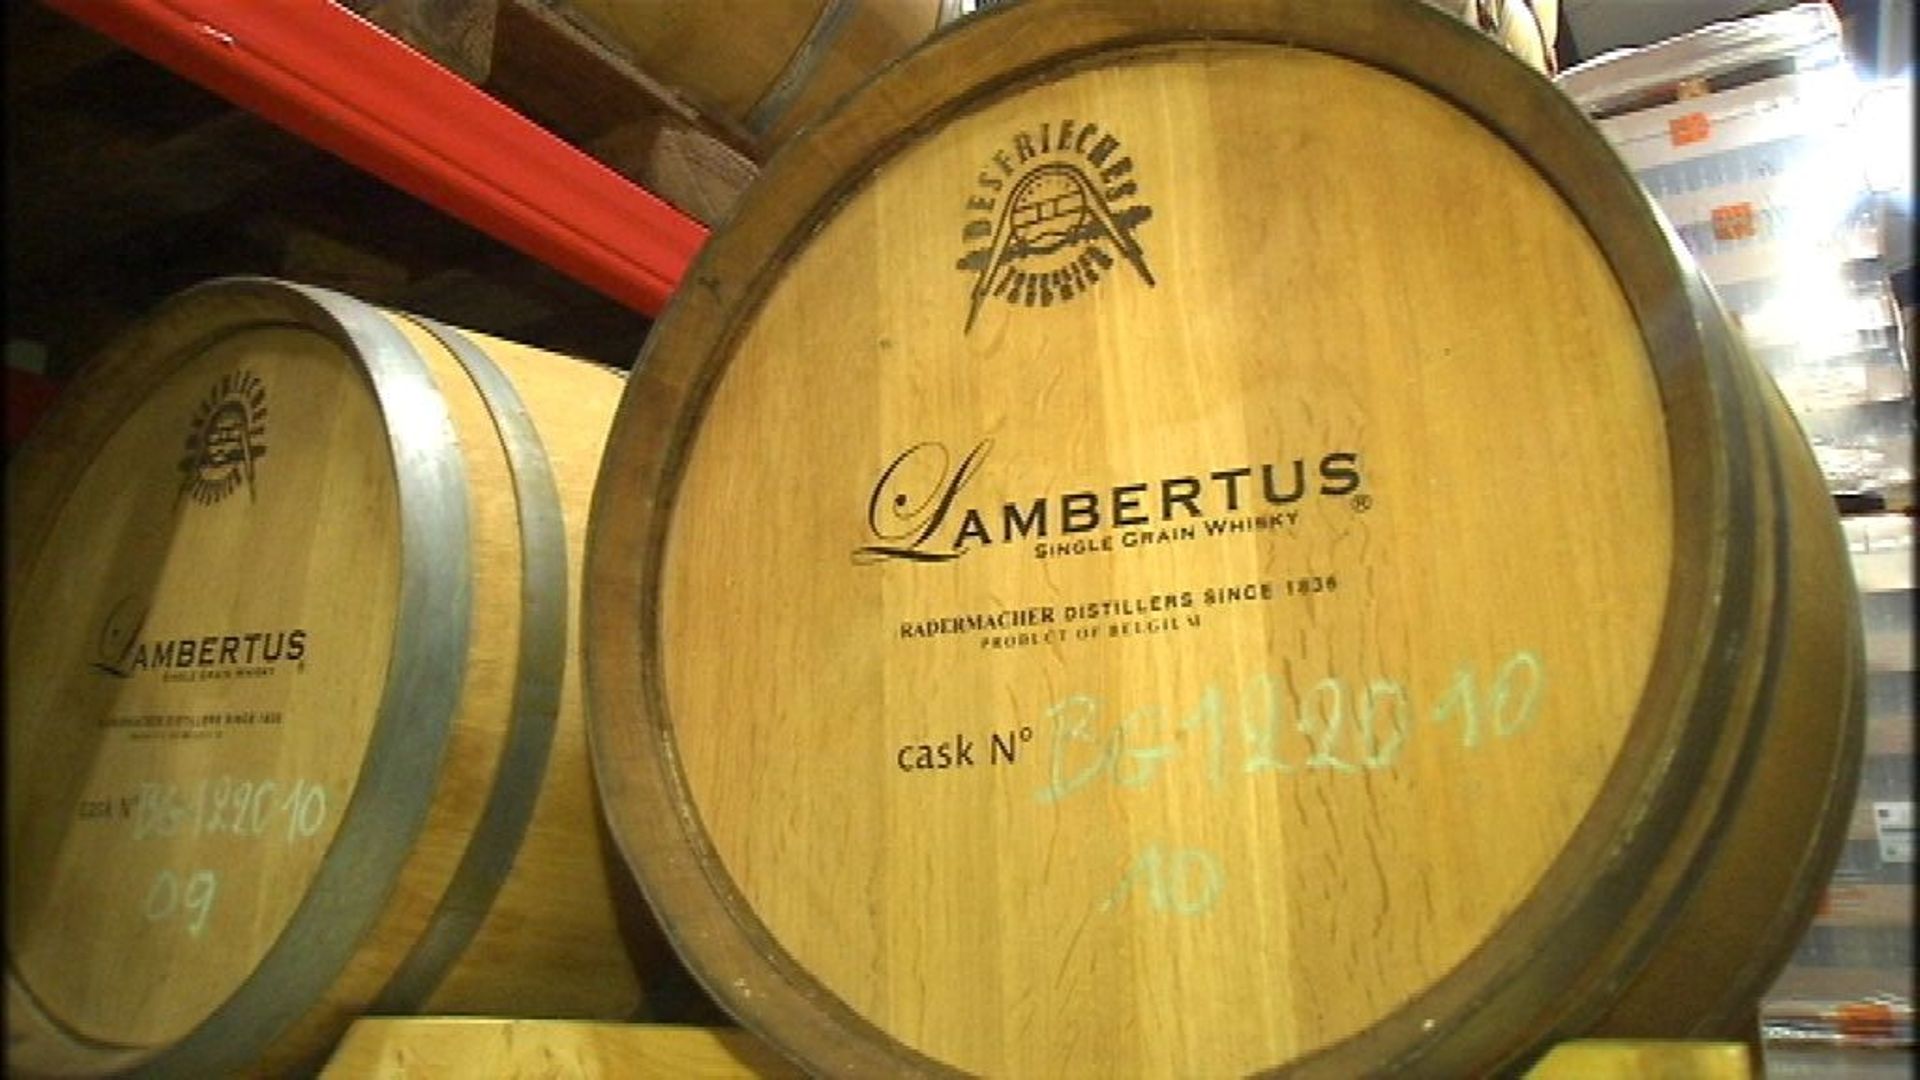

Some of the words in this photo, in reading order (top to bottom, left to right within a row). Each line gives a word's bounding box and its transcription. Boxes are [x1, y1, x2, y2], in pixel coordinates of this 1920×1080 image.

[852, 436, 1362, 564] LAMBERTUS
[1035, 534, 1114, 559] SINGLE
[1122, 528, 1196, 549] GRAIN
[1204, 511, 1299, 537] WHISKY
[88, 593, 307, 679] LAMBERTUS
[900, 606, 1055, 639] RADERMACHER
[1064, 592, 1193, 622] DISTILLERS
[1203, 582, 1273, 606] SINCE
[1076, 626, 1100, 640] OF
[1429, 650, 1543, 749] 10
[896, 735, 975, 773] cask
